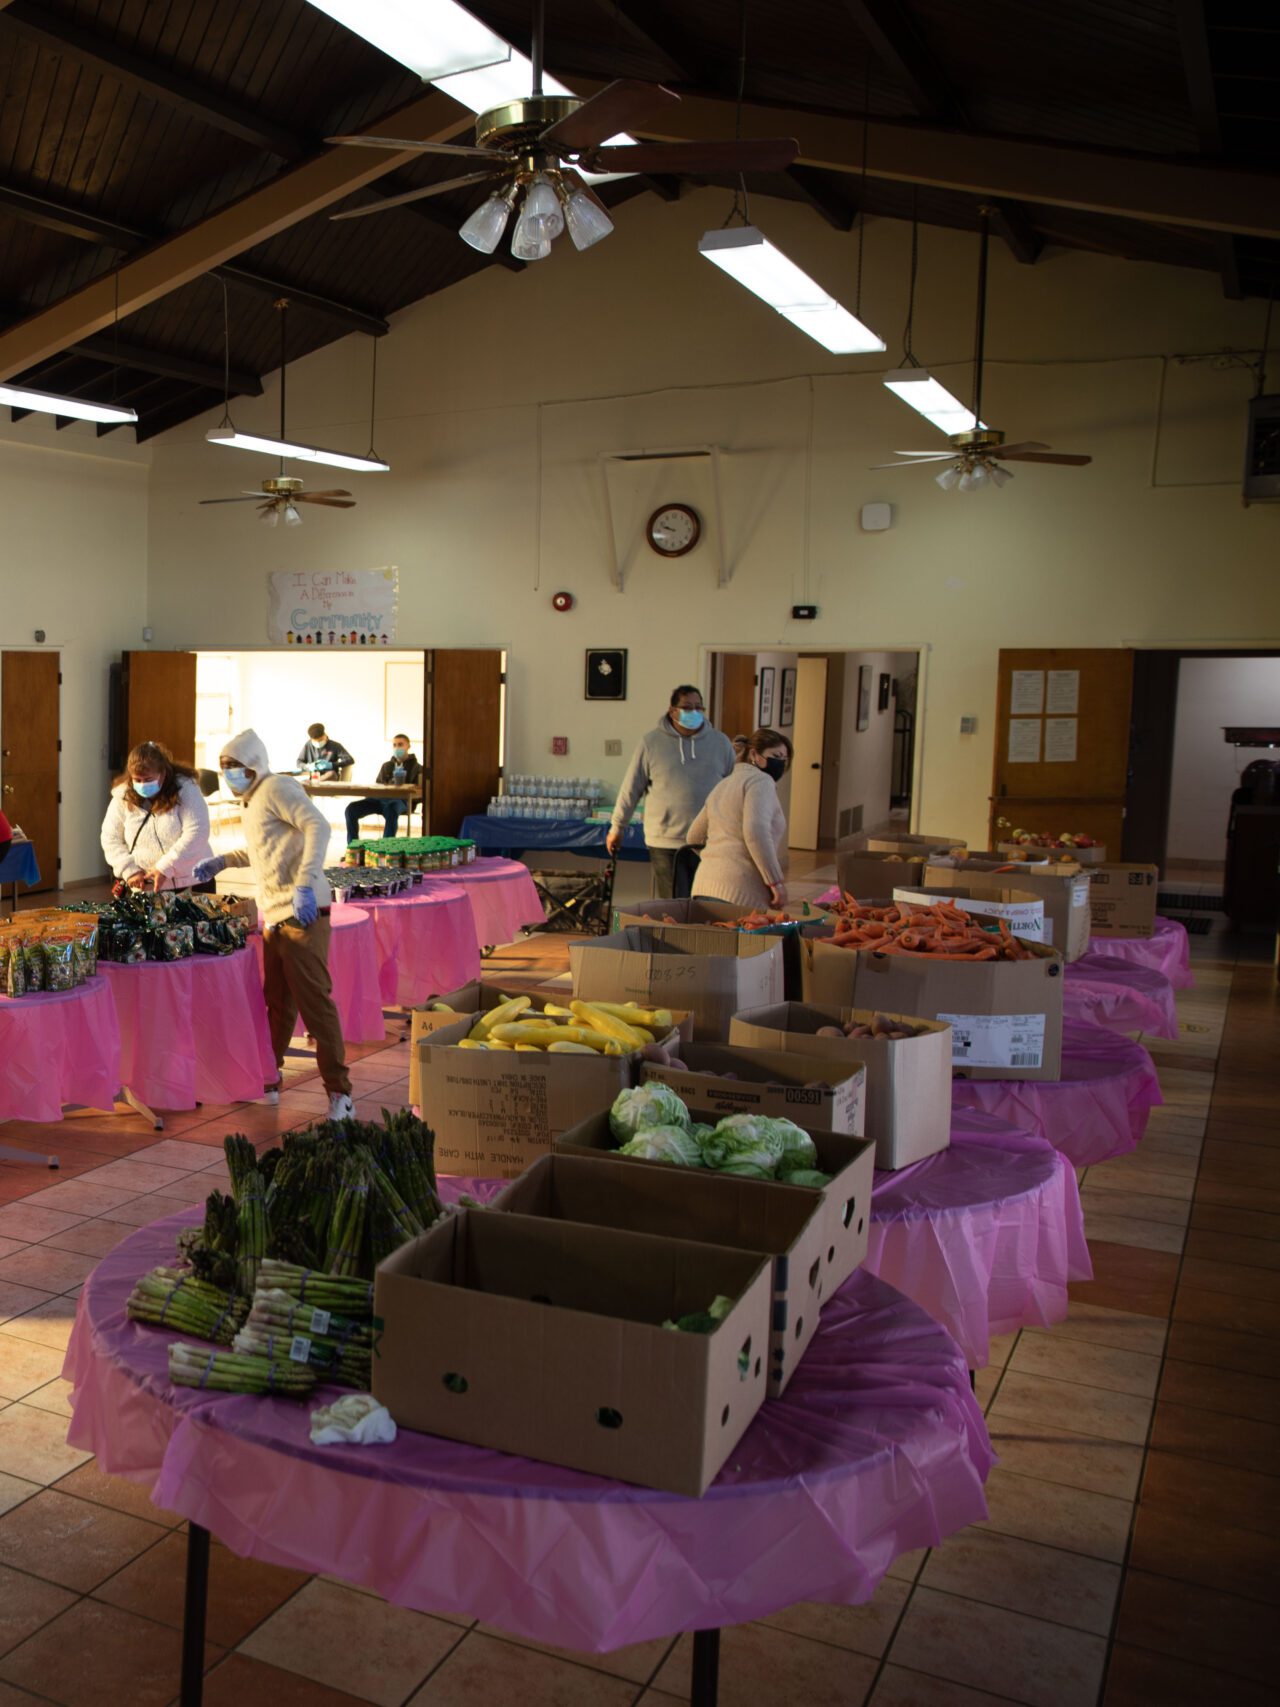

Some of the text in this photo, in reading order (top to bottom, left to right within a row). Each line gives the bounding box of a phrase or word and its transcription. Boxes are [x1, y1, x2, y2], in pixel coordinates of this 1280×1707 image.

[292, 572, 307, 587] I
[312, 572, 332, 586] Can
[291, 608, 384, 632] Community
[787, 1089, 821, 1105] 00591
[438, 1147, 524, 1164] HANDLE WITH CARE
